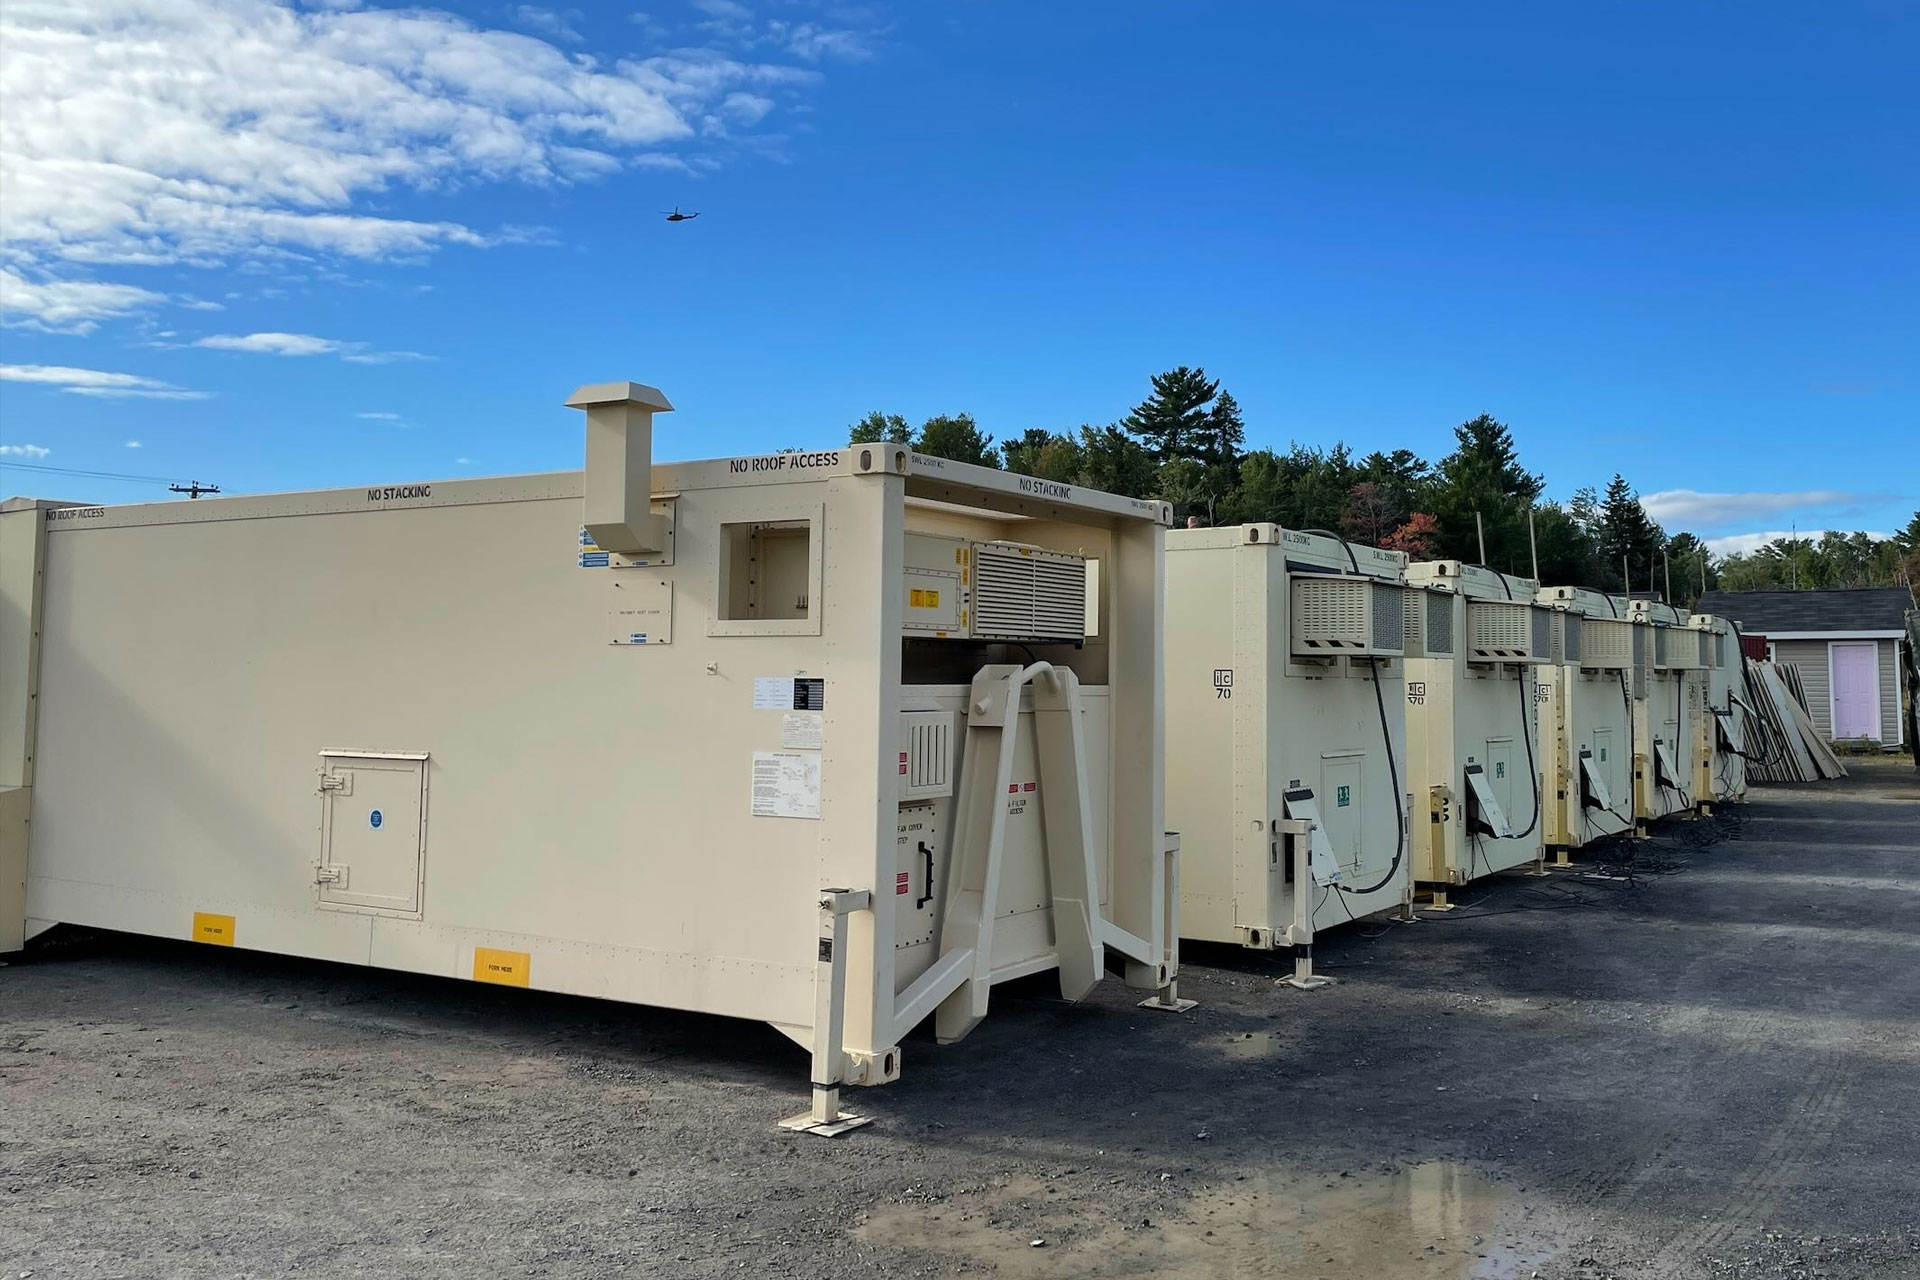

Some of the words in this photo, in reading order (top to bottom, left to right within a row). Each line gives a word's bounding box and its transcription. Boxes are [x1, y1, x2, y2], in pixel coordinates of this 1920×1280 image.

[730, 459, 748, 473] NO
[752, 456, 785, 471] ROOF
[790, 452, 839, 468] ACCESS
[368, 489, 381, 501] NO
[384, 486, 431, 500] STACKING
[1020, 478, 1031, 491] NO
[1033, 481, 1071, 499] STACKING
[46, 509, 57, 521] NO
[58, 510, 77, 520] ROOF
[78, 508, 104, 519] ACCESS
[1216, 688, 1231, 699] 70
